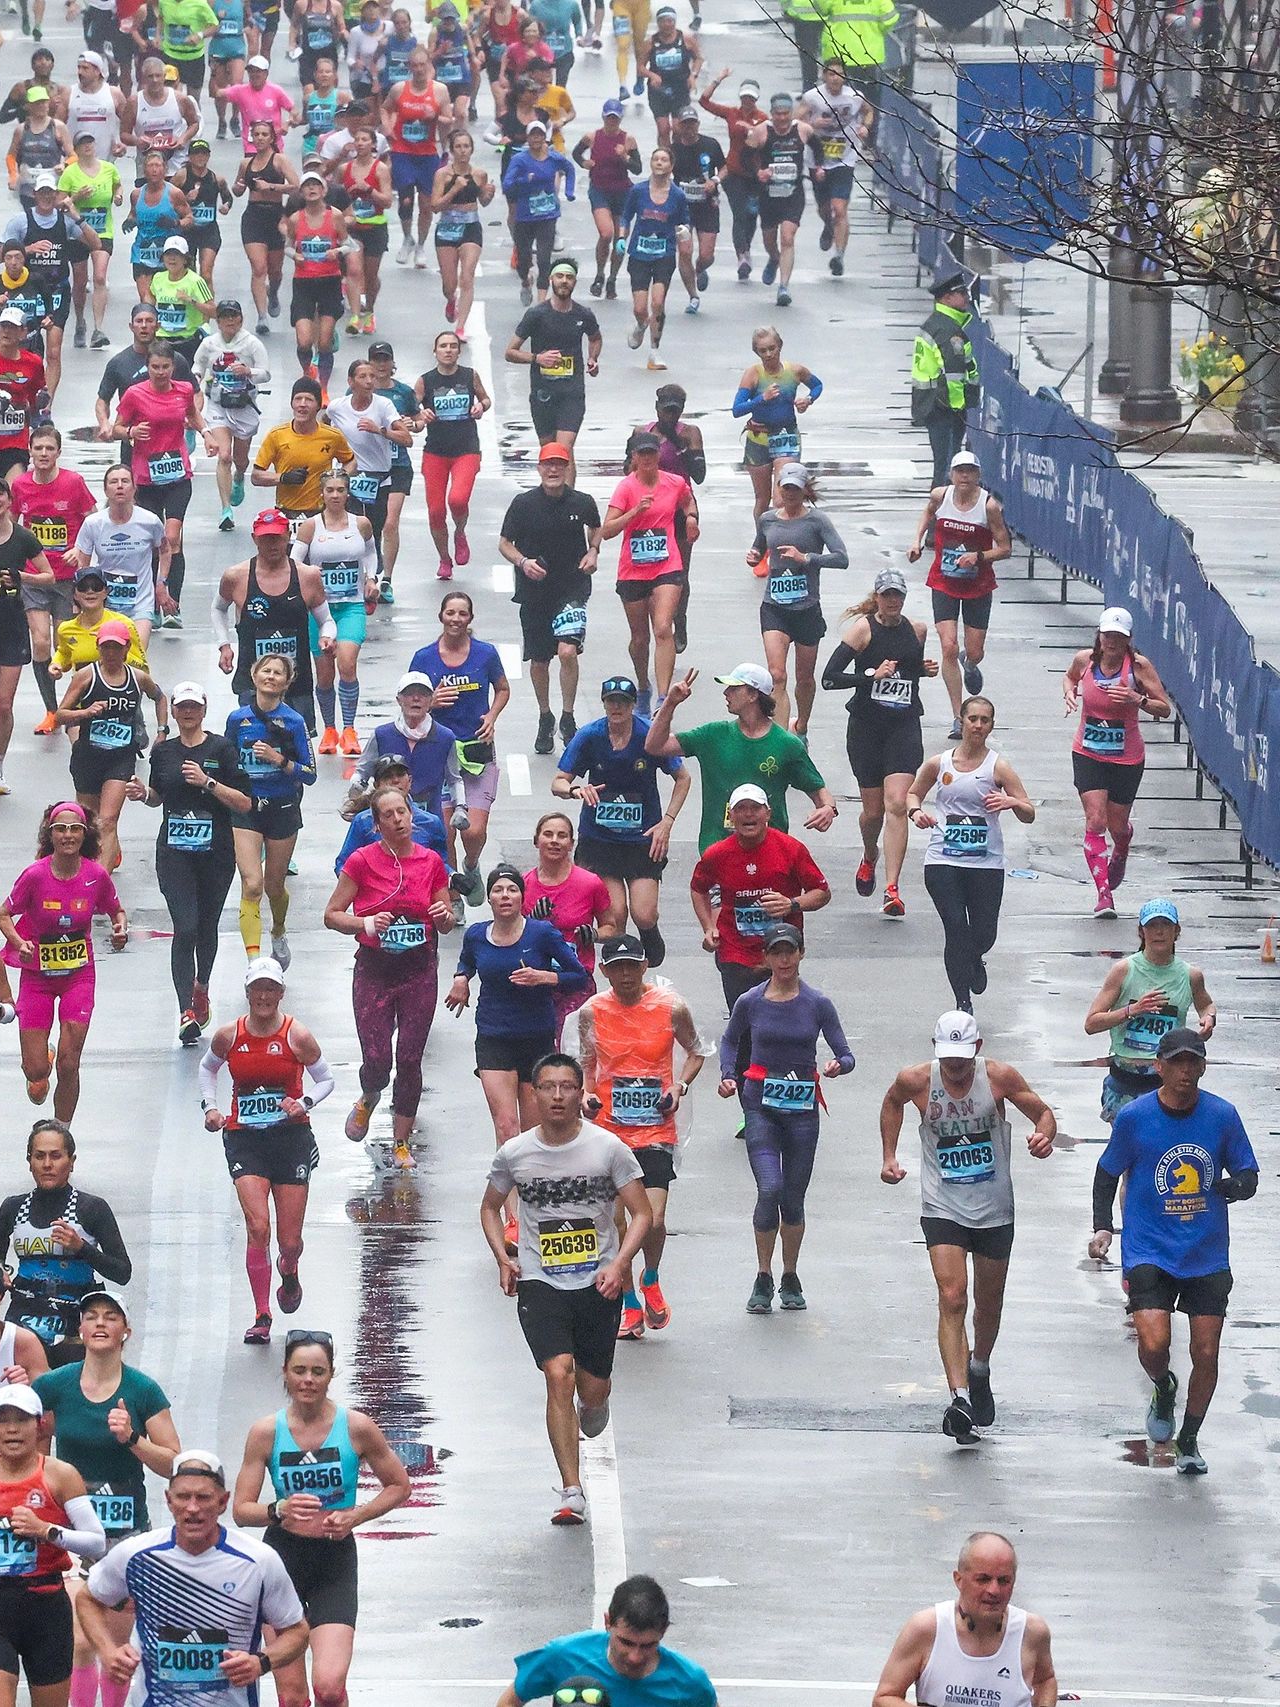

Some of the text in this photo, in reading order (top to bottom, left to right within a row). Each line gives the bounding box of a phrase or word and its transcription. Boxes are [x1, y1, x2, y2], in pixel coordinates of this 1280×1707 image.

[35, 250, 58, 259] FOR
[434, 396, 469, 410] 23032
[943, 520, 976, 532] CANADA
[631, 538, 668, 554] 21832
[442, 673, 470, 686] Kim
[874, 680, 912, 698] 12471
[91, 719, 131, 740] 22627
[597, 804, 641, 822] 22260
[169, 822, 212, 840] 22577
[943, 828, 988, 845] 22595
[40, 942, 87, 962] 31352
[764, 1082, 815, 1102] 22427
[931, 1089, 945, 1102] GO
[929, 1098, 974, 1120] DAN
[939, 1146, 994, 1169] 20063
[1157, 1164, 1167, 1192] BOSTON
[1164, 1146, 1194, 1165] ATHLETIC
[1164, 1203, 1207, 1212] MARATHON
[541, 1233, 597, 1257] 25639
[281, 1467, 343, 1493] 19356
[945, 1684, 1002, 1701] QUAKERS
